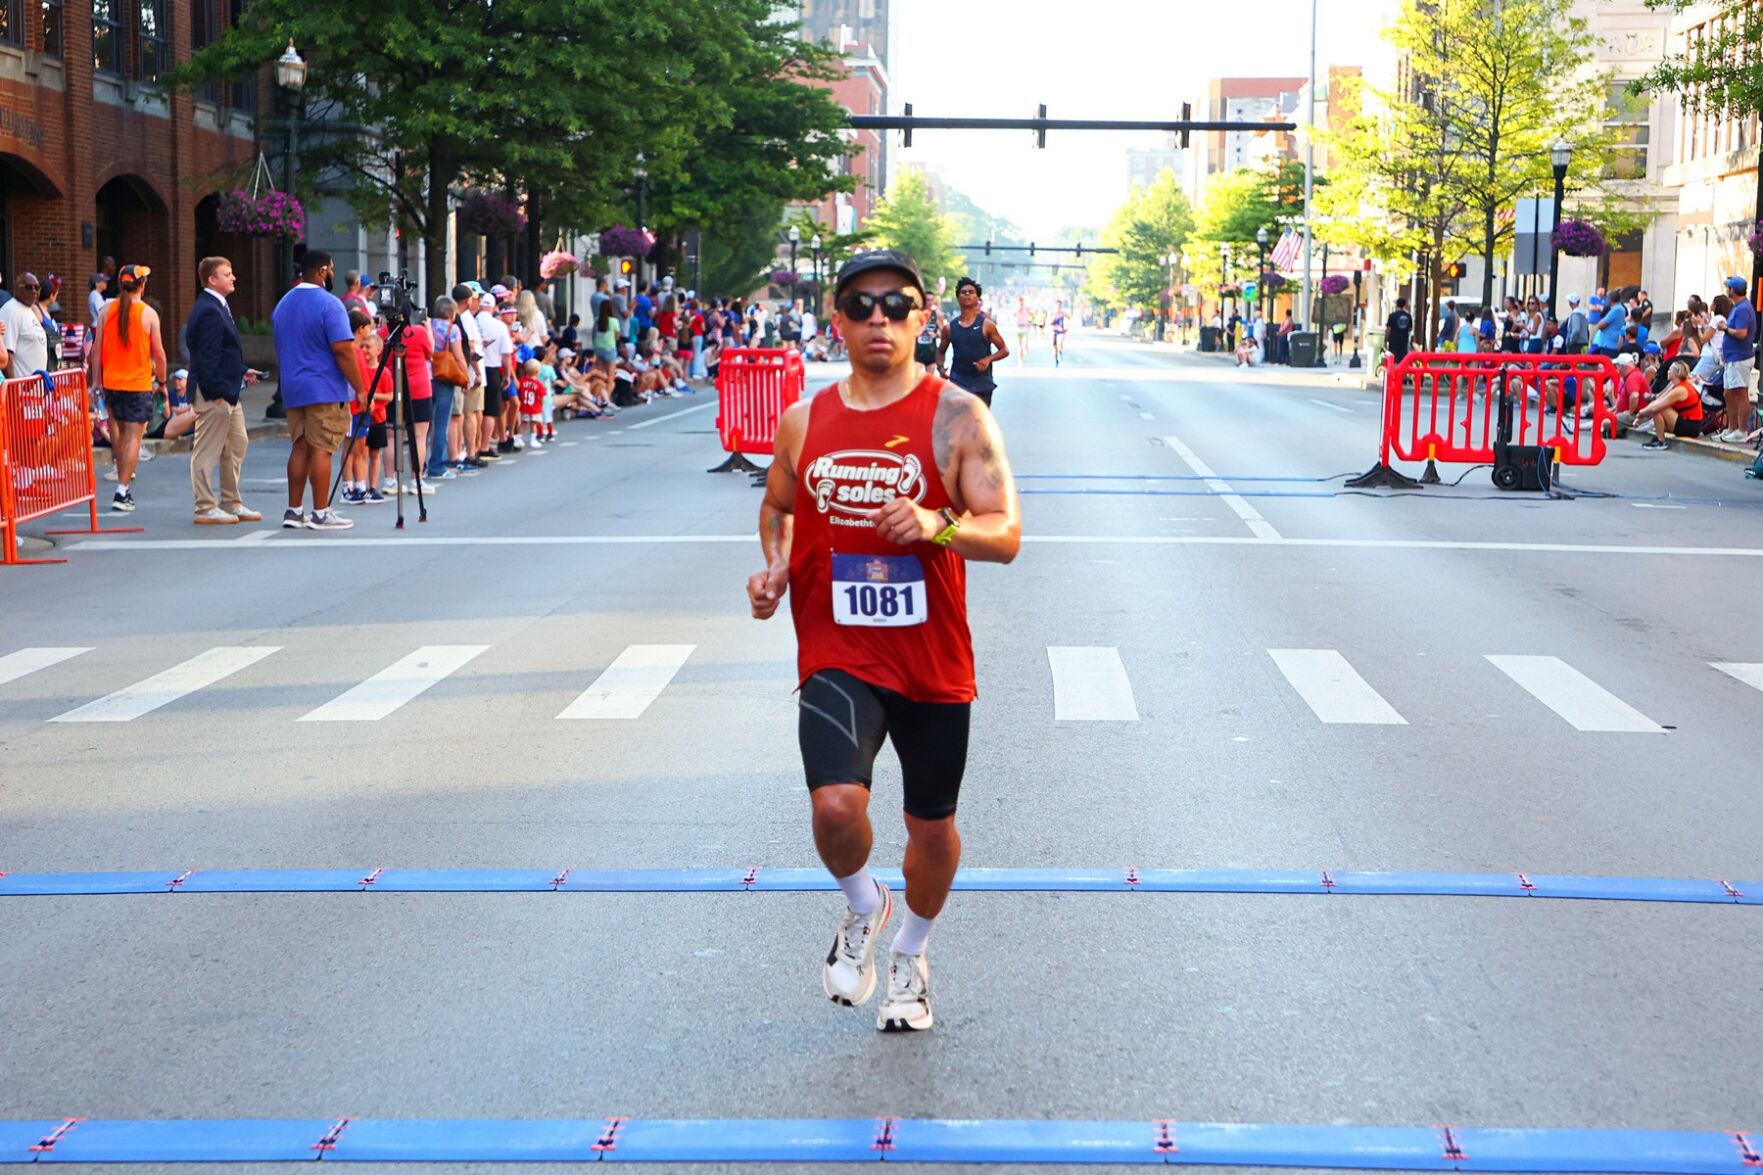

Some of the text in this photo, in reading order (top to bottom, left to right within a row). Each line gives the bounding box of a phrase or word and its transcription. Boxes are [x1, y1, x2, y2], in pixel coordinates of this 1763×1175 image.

[523, 390, 536, 406] 19
[813, 457, 901, 485] Running
[836, 481, 896, 503] soles
[844, 585, 914, 617] 1081
